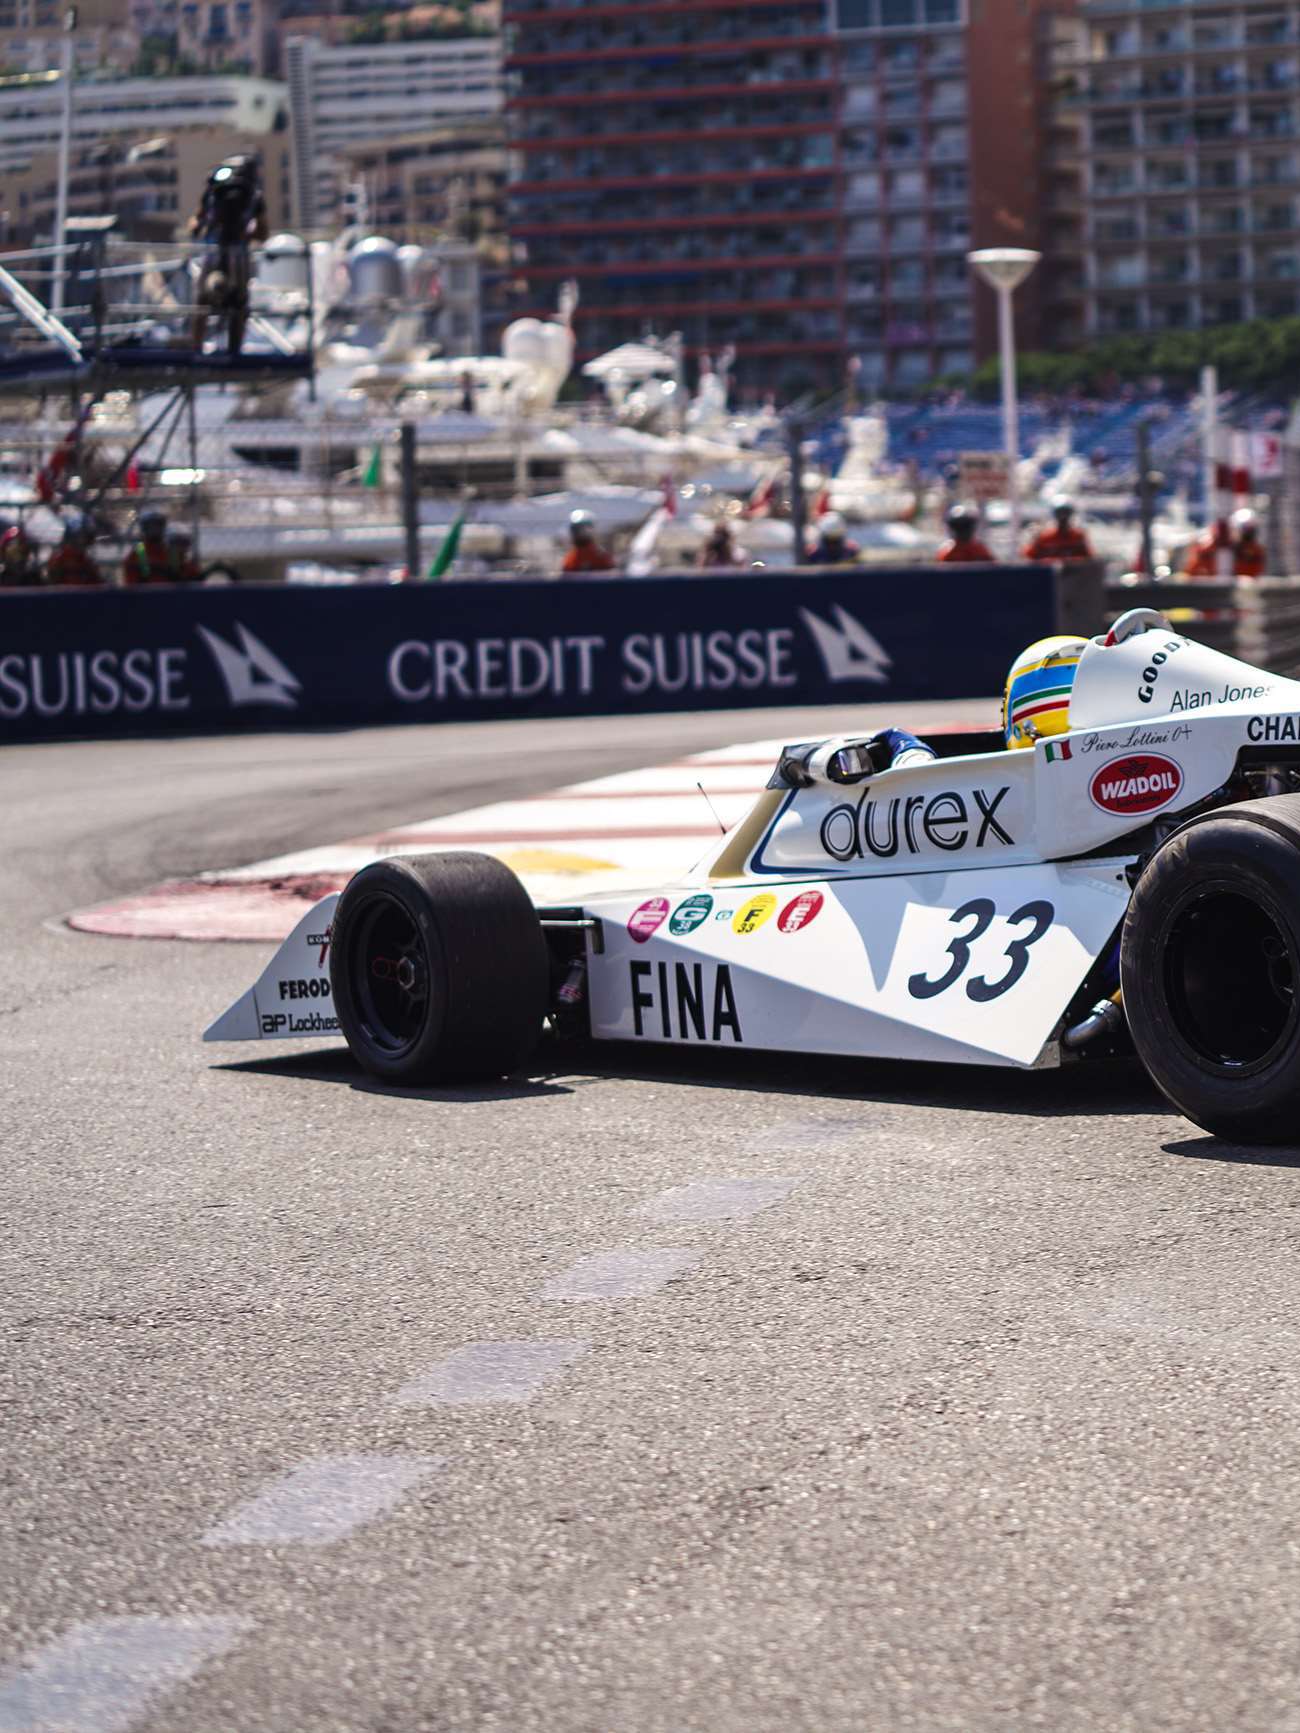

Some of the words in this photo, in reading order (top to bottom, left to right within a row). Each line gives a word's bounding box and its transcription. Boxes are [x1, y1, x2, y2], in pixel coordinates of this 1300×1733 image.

[0, 647, 190, 718] SUISSE
[388, 634, 605, 702] CREDIT
[621, 627, 797, 694] SUISSE
[1169, 688, 1212, 713] Alan
[1119, 726, 1170, 748] Lottini
[1100, 771, 1177, 801] WLADOIL
[819, 785, 1015, 862] durex
[737, 922, 755, 933] 33
[744, 908, 763, 922] F
[908, 898, 1055, 1003] 33
[629, 960, 742, 1042] FINA
